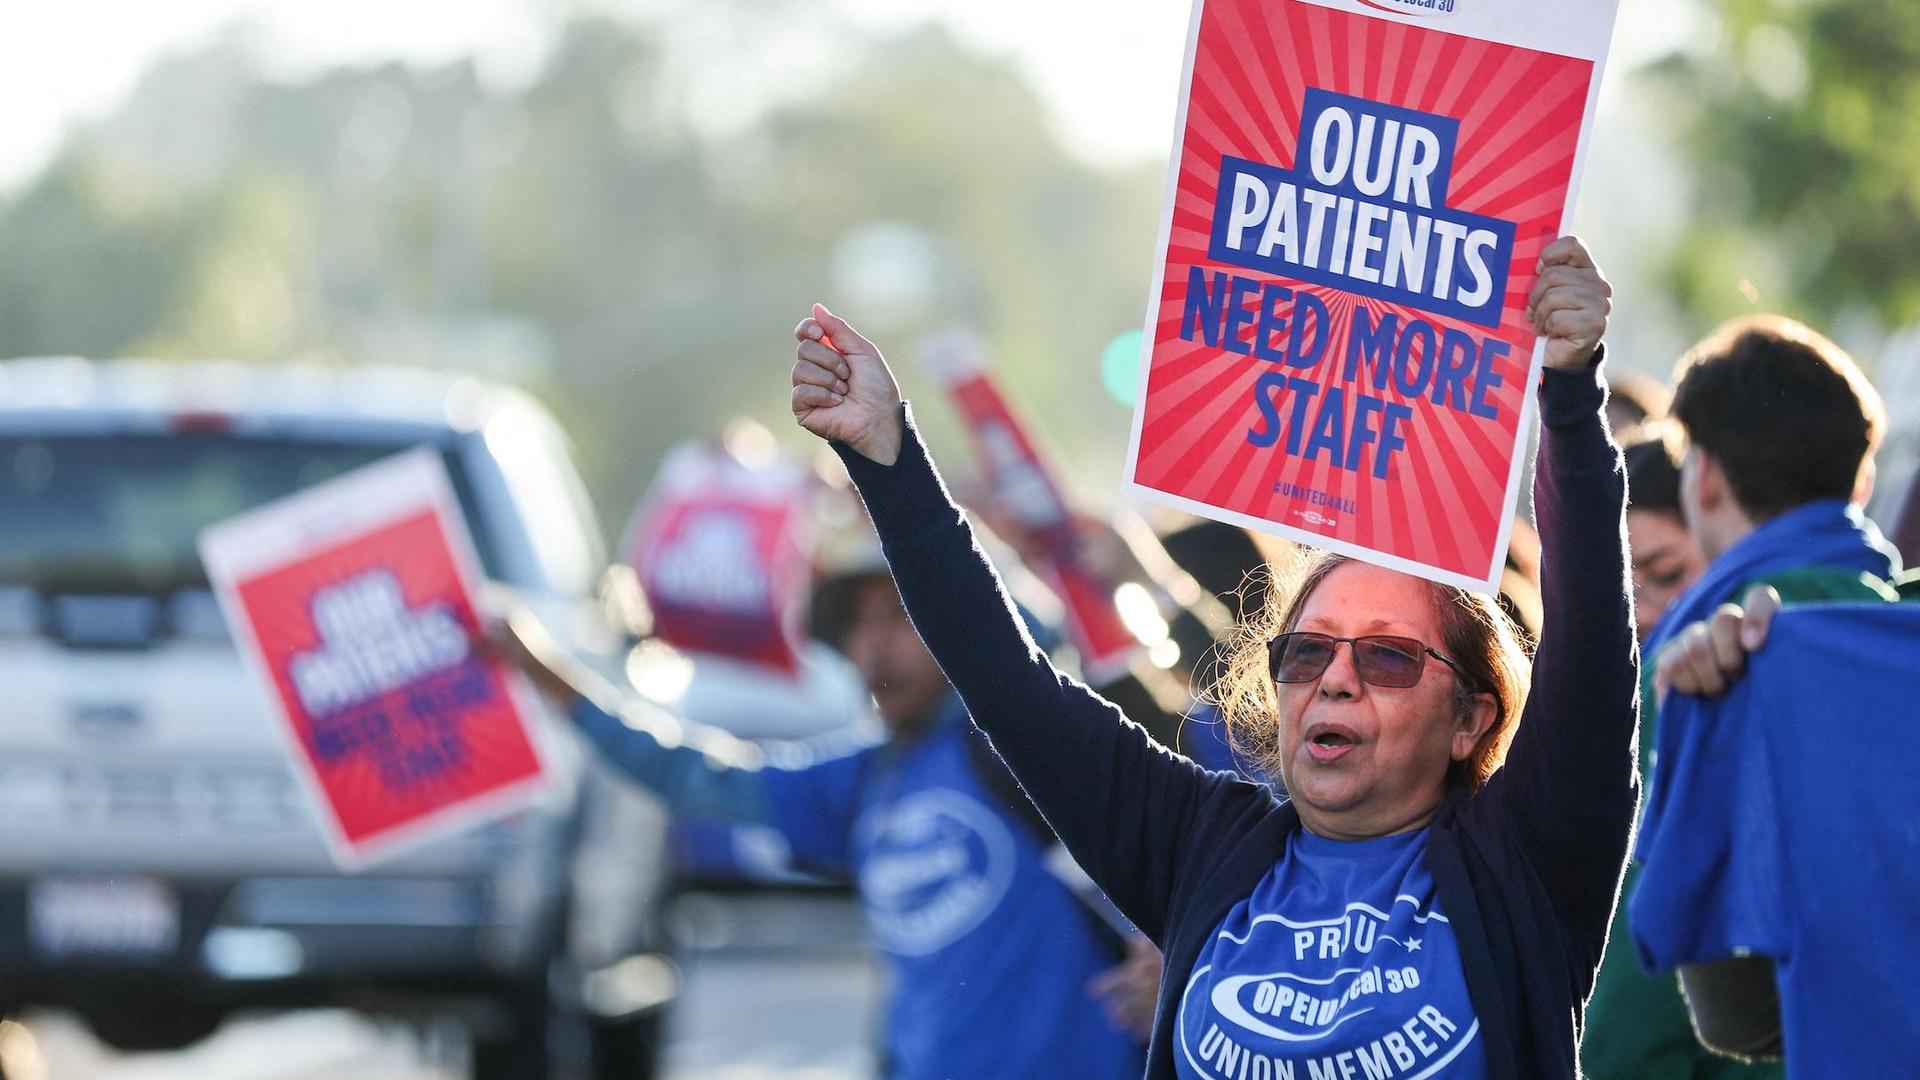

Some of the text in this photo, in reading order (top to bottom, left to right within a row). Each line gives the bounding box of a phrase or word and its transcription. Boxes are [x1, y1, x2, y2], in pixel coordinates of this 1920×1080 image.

[1309, 105, 1441, 210] OUR
[1224, 171, 1499, 308] PATIENTS
[1180, 266, 1511, 420] NEED MORE
[1247, 372, 1413, 480] STAFF
[1272, 480, 1356, 515] #UNITED4ALL
[1384, 966, 1421, 994] 30
[1199, 1004, 1458, 1080] UNION MEMBER
